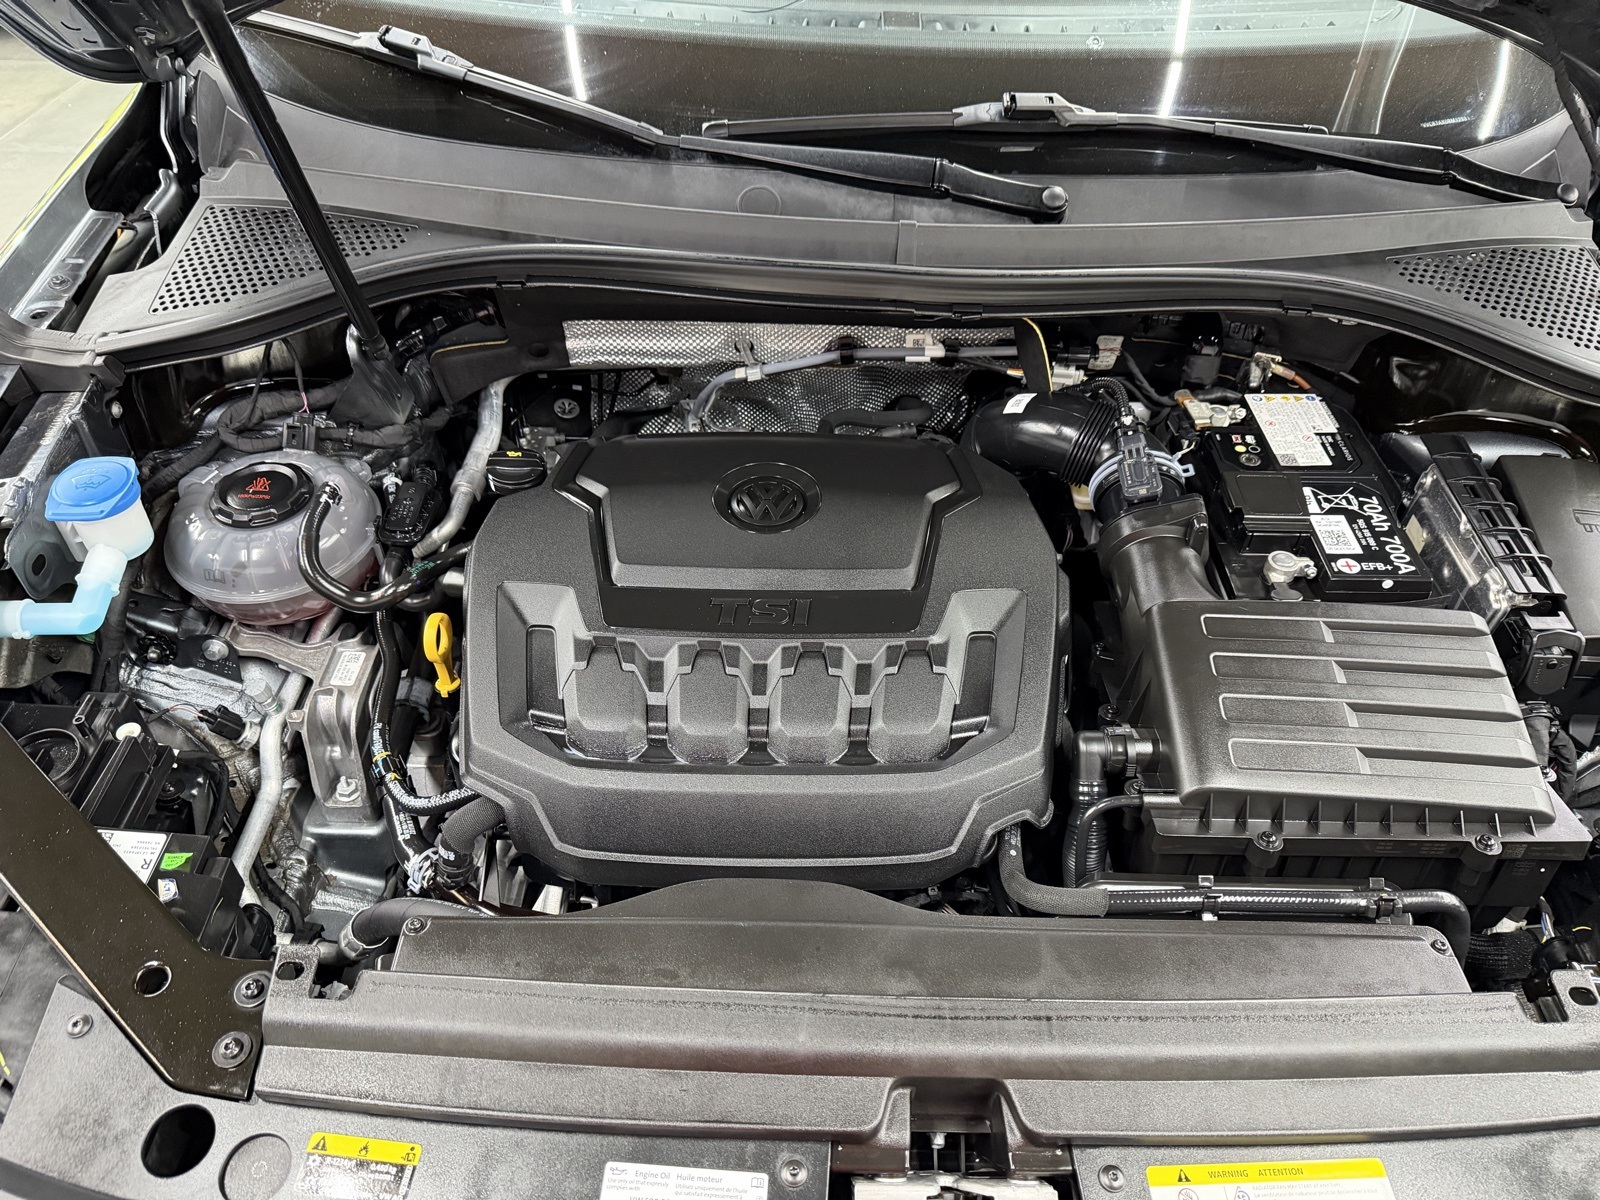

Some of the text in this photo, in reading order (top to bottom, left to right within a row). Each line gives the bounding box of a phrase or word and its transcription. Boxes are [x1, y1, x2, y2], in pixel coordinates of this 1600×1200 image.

[1337, 440, 1354, 461] CLARIOS
[1358, 496, 1416, 574] 70Ah 700A
[1361, 562, 1393, 571] EFB+
[710, 597, 812, 626] TSI
[140, 858, 153, 870] R
[635, 1170, 659, 1180] Engine
[660, 1172, 671, 1180] Oil
[676, 1173, 695, 1182] Huile
[1207, 1167, 1304, 1179] WARNING ATTENTION
[683, 1190, 703, 1198] satisfait
